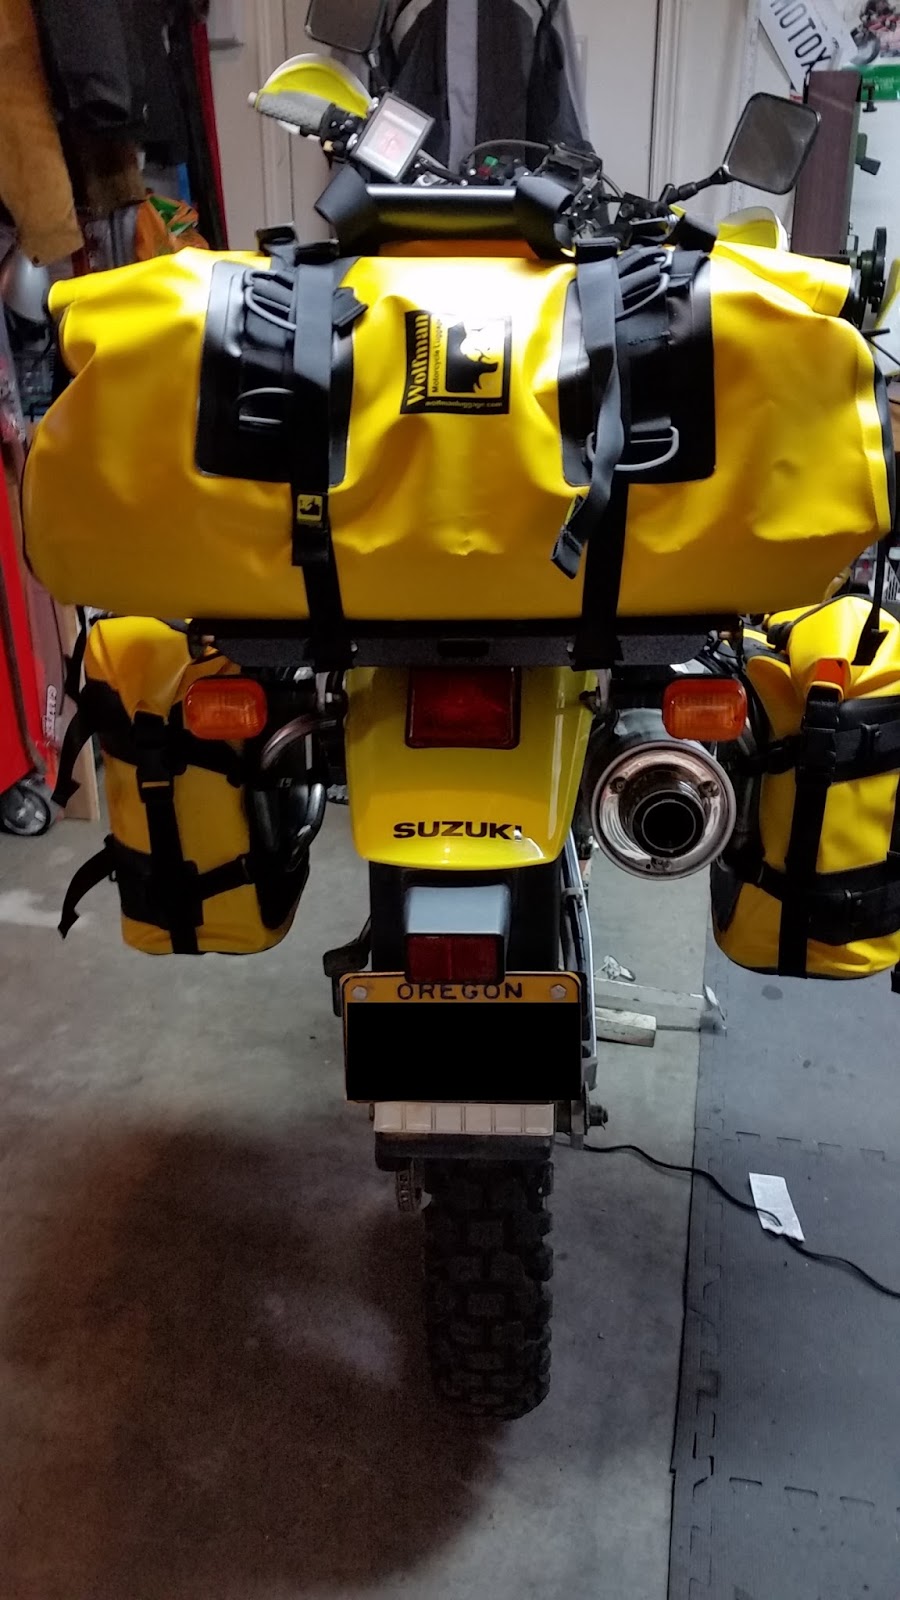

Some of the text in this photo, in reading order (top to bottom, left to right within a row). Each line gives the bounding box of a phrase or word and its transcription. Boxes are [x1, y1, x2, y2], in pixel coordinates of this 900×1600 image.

[406, 314, 429, 406] Wolfman
[432, 350, 441, 392] Motorcycle
[424, 400, 503, 409] wolfmanluggage.com
[393, 821, 522, 840] SUZUKI
[397, 982, 523, 1000] OREGON
